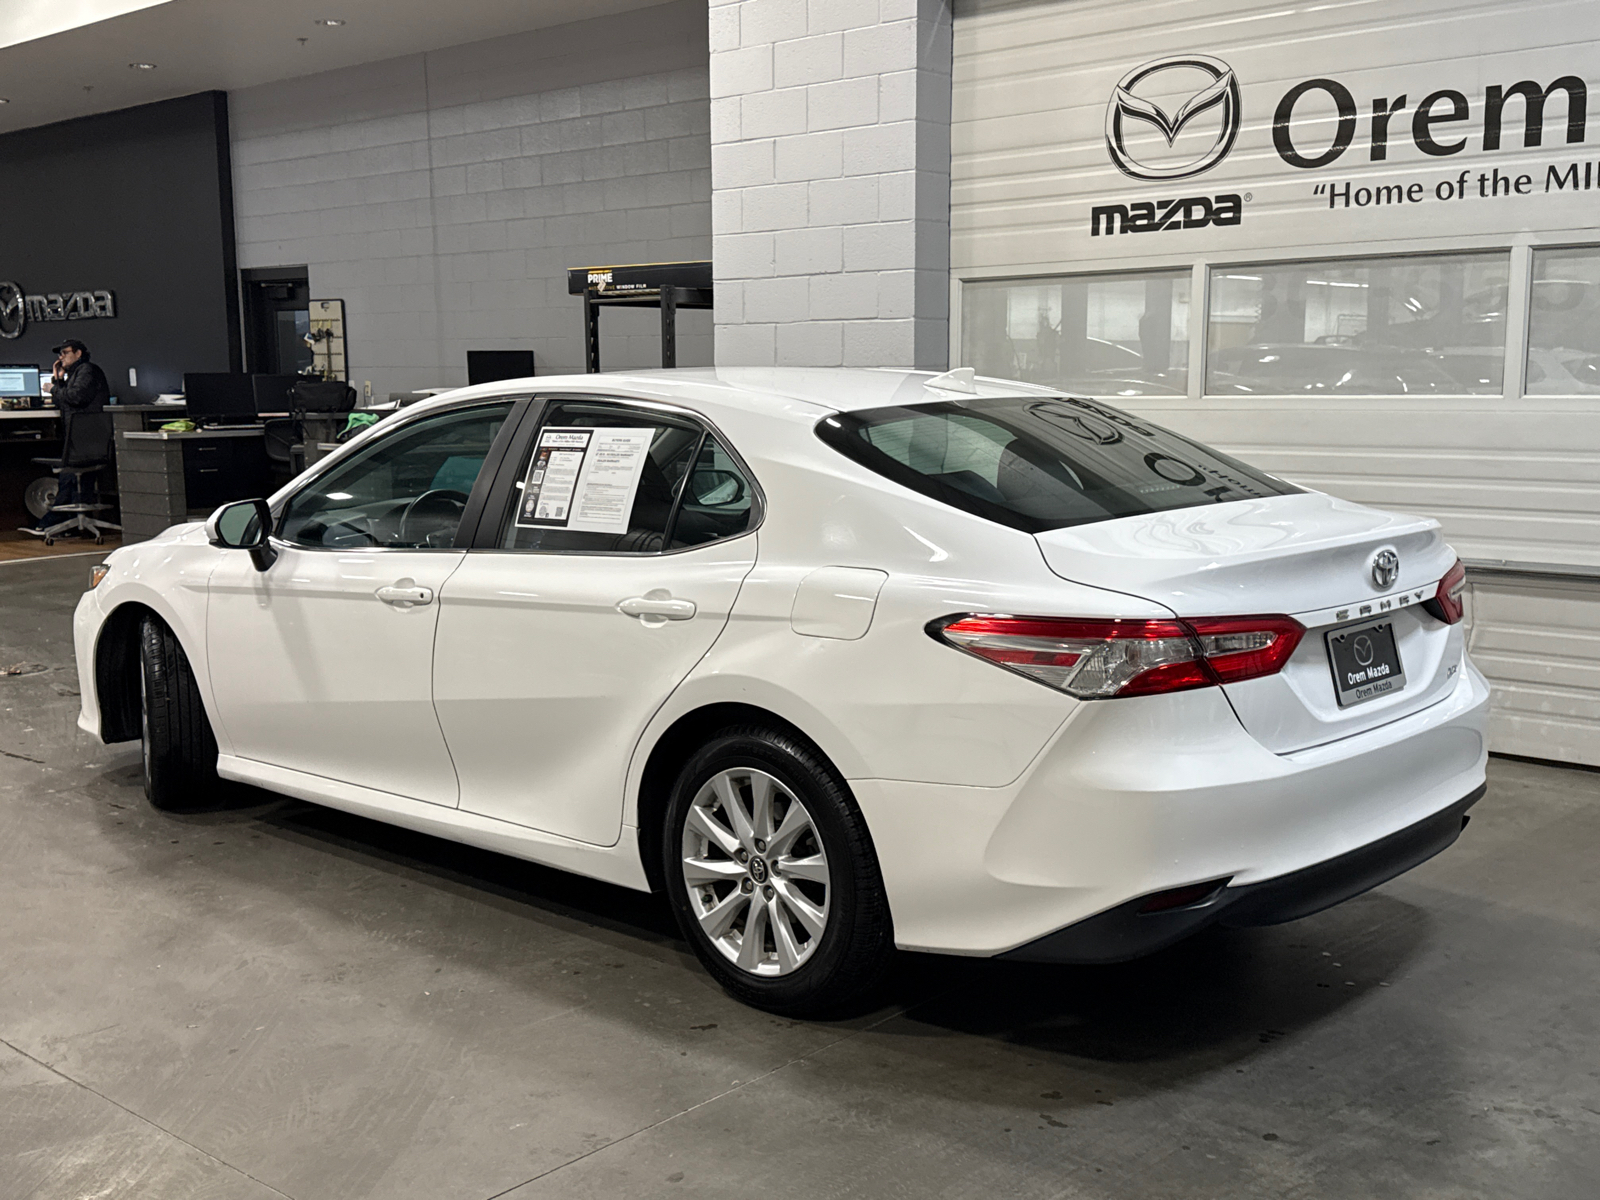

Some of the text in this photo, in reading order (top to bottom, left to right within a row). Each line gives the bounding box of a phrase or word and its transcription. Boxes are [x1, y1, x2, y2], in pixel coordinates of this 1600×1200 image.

[1272, 76, 1587, 168] Orem
[1435, 170, 1471, 201] of
[1477, 168, 1532, 198] the
[1544, 161, 1600, 193] MI
[588, 273, 613, 283] PRIME
[1348, 663, 1390, 685] Orem Mazda
[1356, 680, 1392, 699] Orem Mazda
